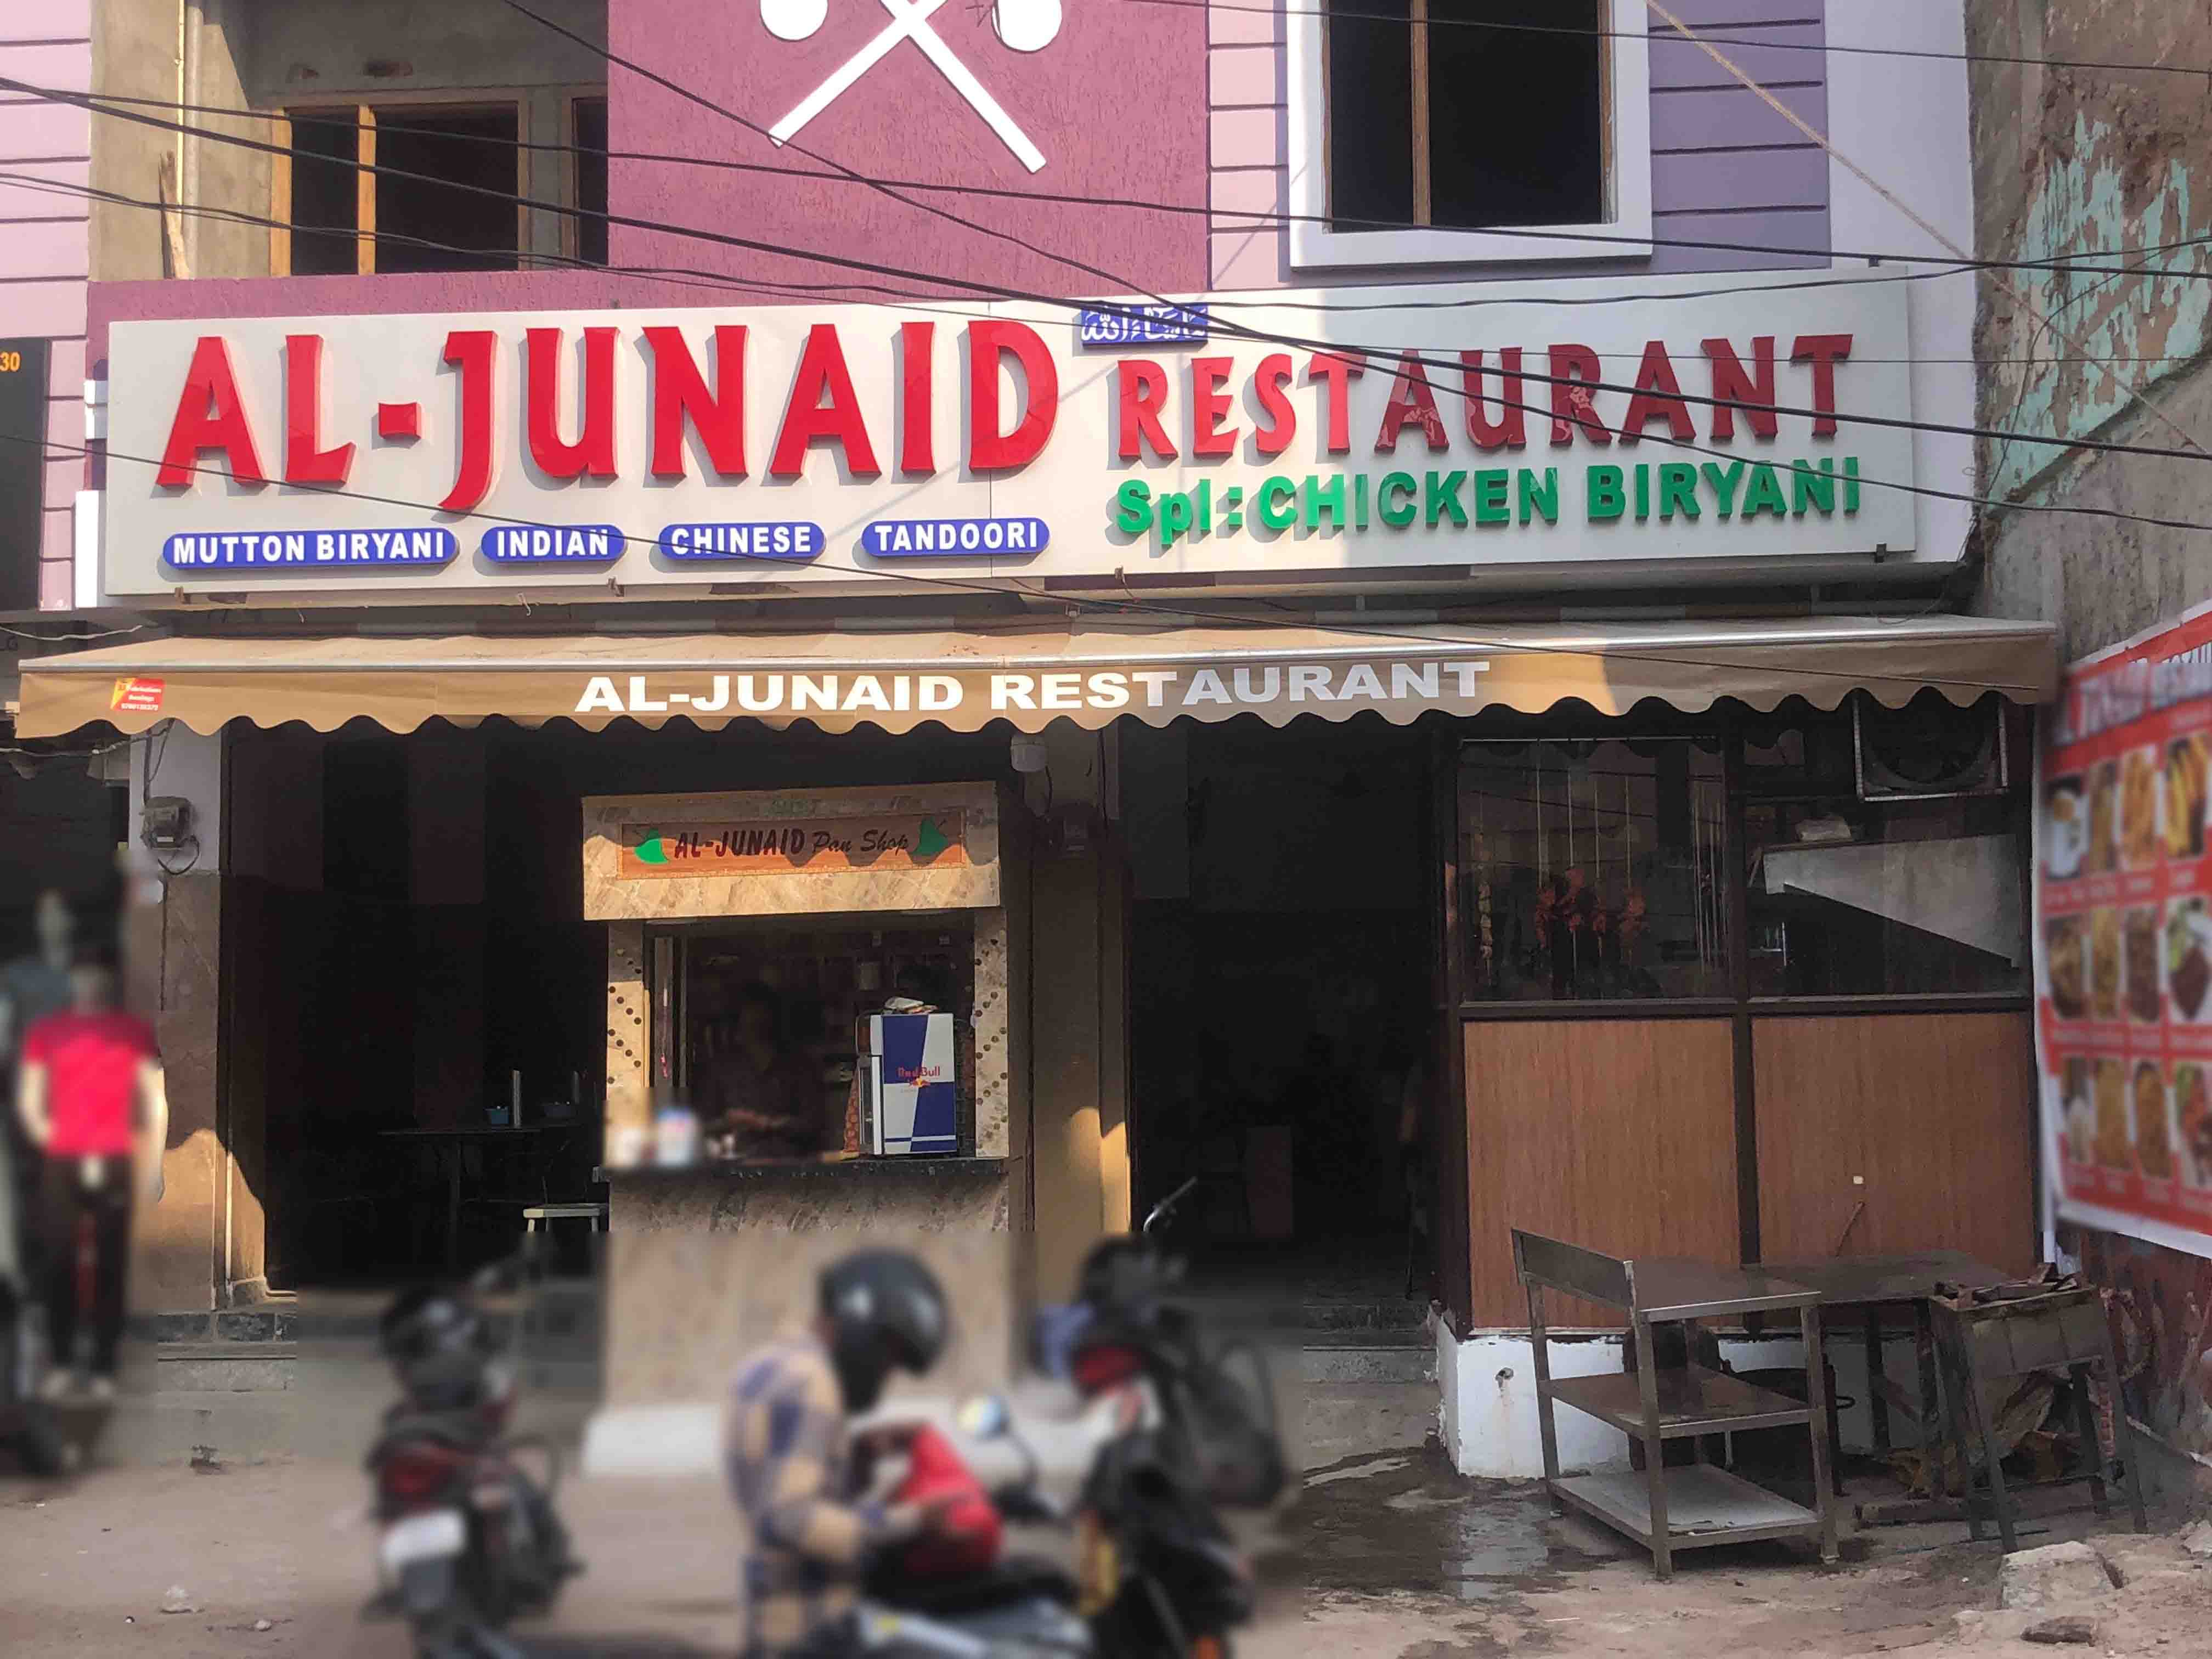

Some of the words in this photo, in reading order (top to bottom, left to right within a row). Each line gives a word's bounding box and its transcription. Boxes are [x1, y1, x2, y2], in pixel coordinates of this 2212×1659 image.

[156, 319, 1060, 514] AL-JUNAID
[1116, 334, 1854, 459] RESTAURANT
[1587, 456, 1861, 522] BIRYANI
[173, 534, 305, 564] MUTTON
[317, 531, 444, 561] BIRYANI
[496, 527, 608, 557] INDIAN
[671, 525, 811, 555] CHINESE
[874, 522, 1037, 552] TANDOORI
[574, 674, 964, 713] AL-JUNAID
[990, 661, 1489, 711] RESTAURANT
[674, 828, 805, 859] AL-JUNAID
[811, 830, 853, 853] Pan
[860, 829, 909, 856] Shop
[922, 1065, 940, 1076] Bull
